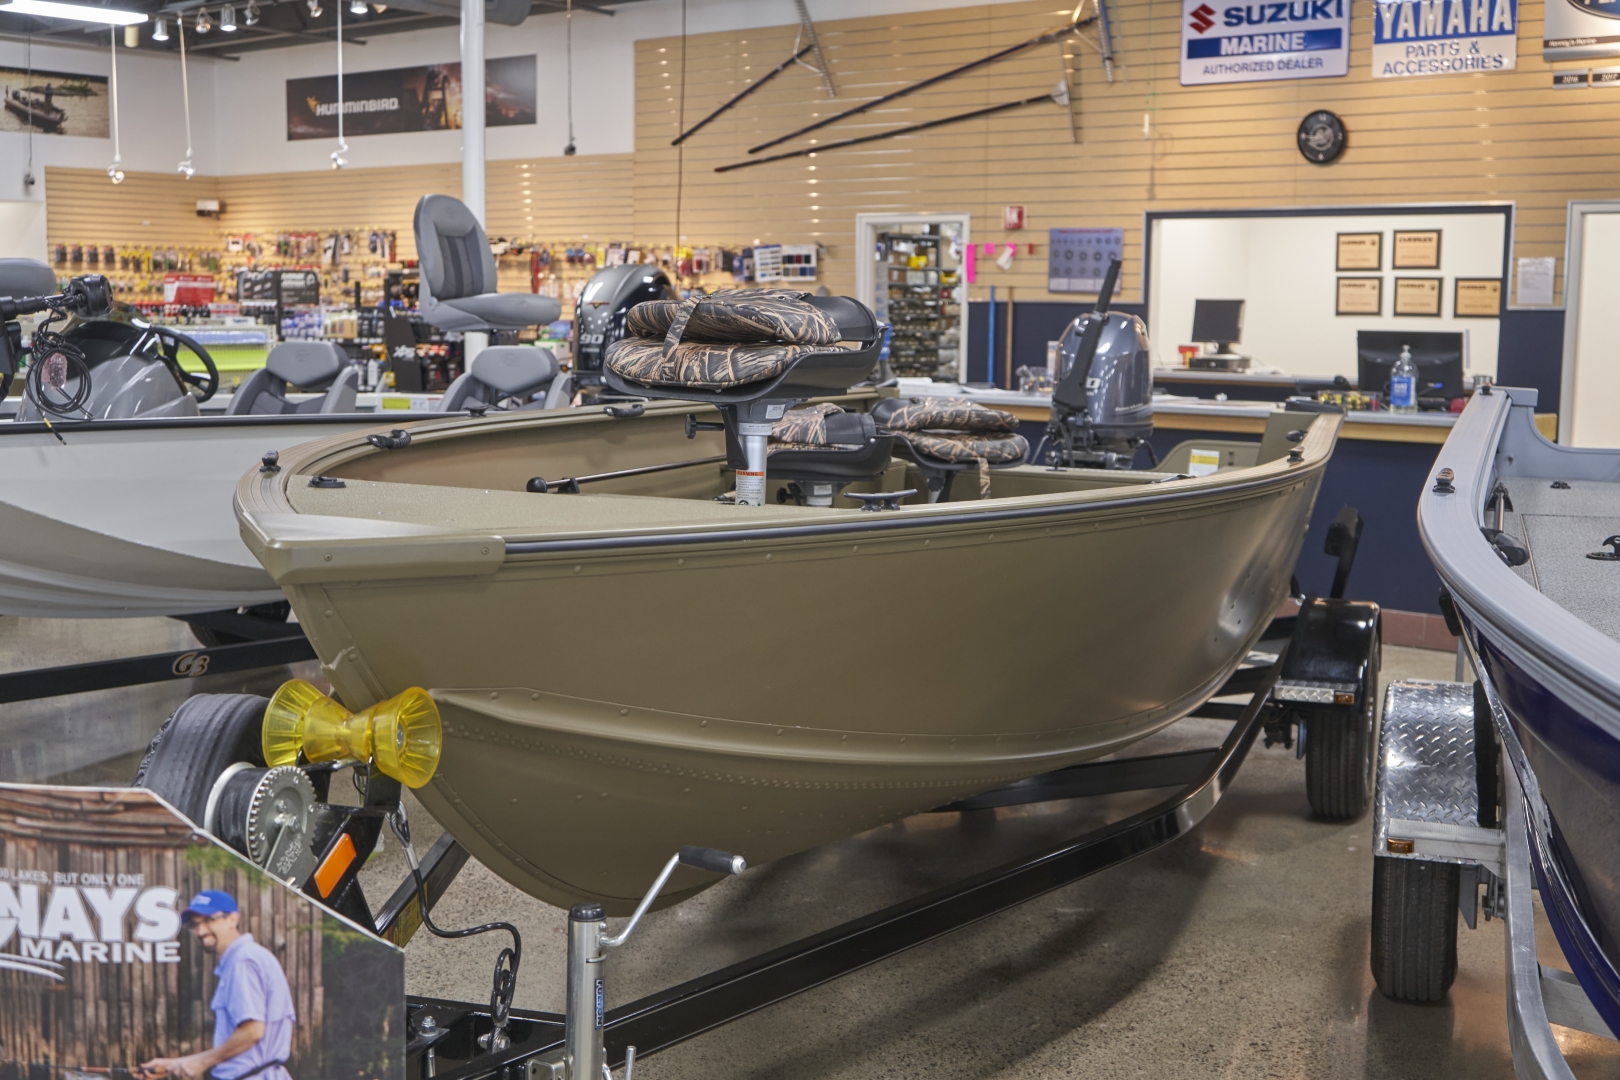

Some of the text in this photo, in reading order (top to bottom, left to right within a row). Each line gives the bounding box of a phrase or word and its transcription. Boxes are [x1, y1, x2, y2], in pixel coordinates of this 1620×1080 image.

[1223, 0, 1343, 27] SUZUKI
[1379, 0, 1513, 40] YAMAHA
[1220, 32, 1306, 56] MARINE
[1405, 38, 1480, 58] PARTS &
[1203, 57, 1323, 75] AUTHORIZED DEALER
[1382, 54, 1504, 75] ACCESSORIES
[1562, 74, 1579, 84] 2016
[315, 97, 399, 117] HUMMINBIRD
[579, 333, 604, 345] 90
[1086, 378, 1101, 389] 0
[172, 651, 210, 677] G3
[11, 869, 51, 885] LAKES,
[54, 871, 79, 884] BUT
[81, 872, 114, 886] ONLY
[117, 873, 145, 885] ONE
[0, 881, 182, 942] NAYS
[20, 938, 181, 963] MARINE
[595, 979, 604, 1027] FULTON
